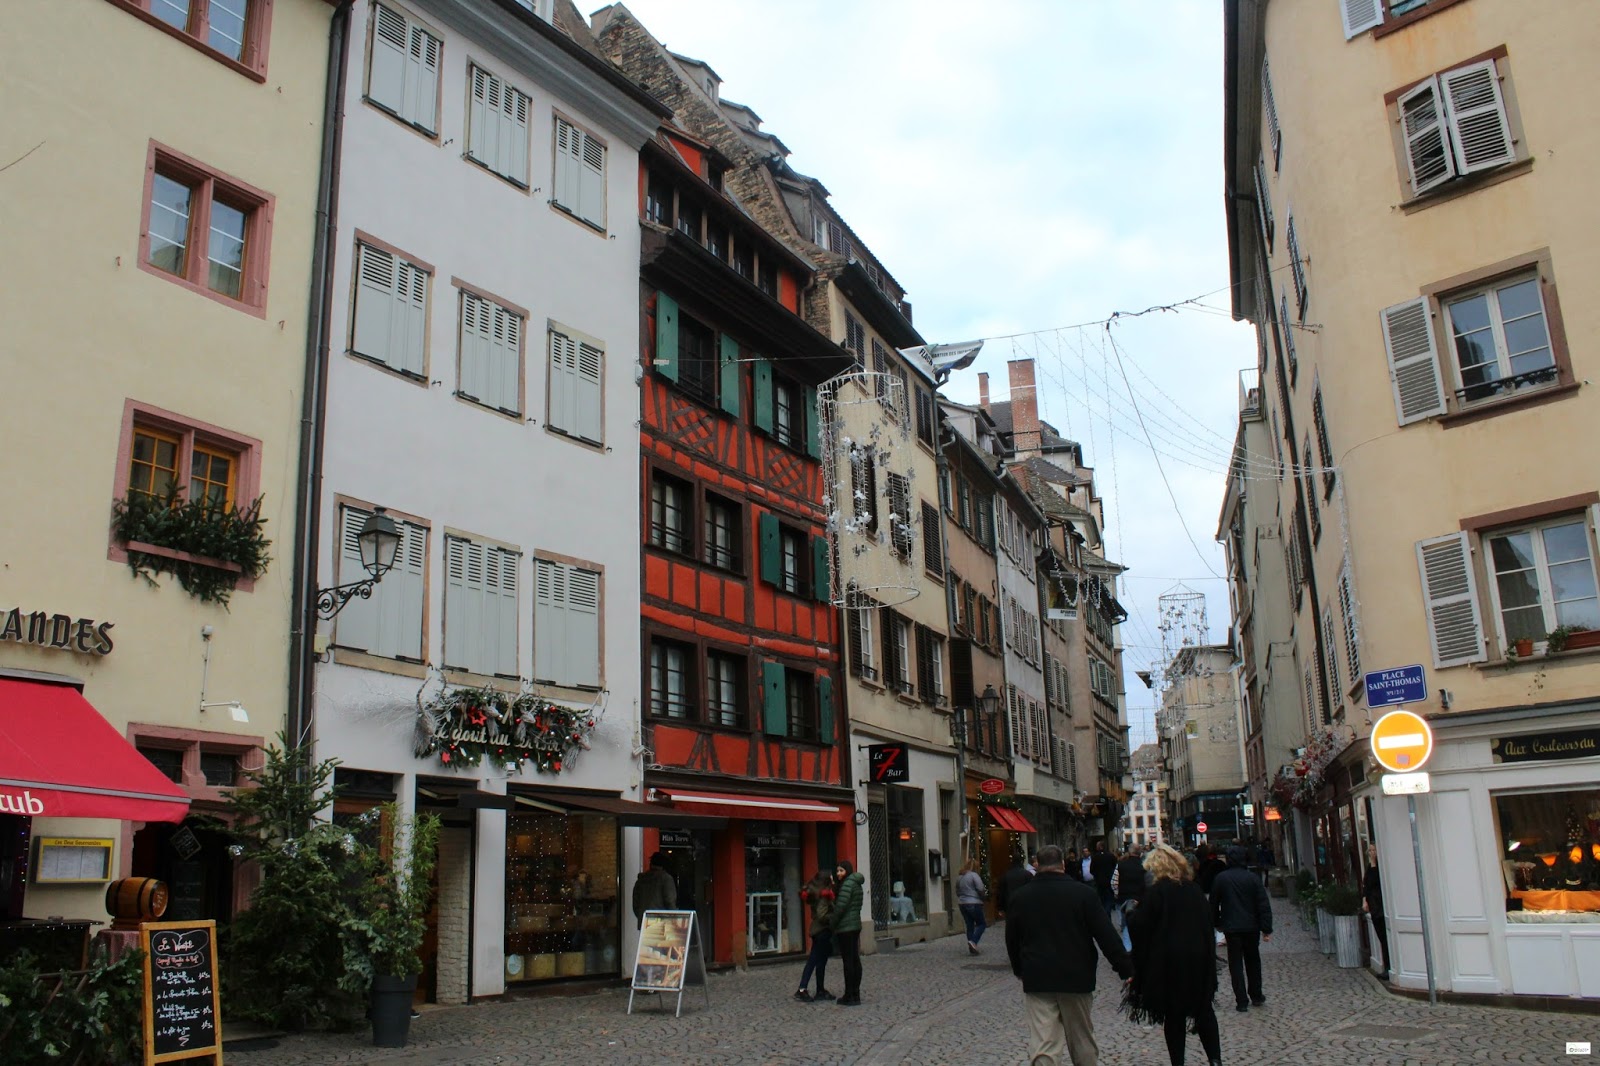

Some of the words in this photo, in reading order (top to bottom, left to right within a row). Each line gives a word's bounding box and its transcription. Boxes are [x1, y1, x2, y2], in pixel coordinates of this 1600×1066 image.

[0, 607, 116, 655] ANDES
[1368, 676, 1421, 691] SAINT-THOMAS
[1382, 671, 1405, 681] PLACE
[1505, 741, 1526, 756] Aux
[1532, 739, 1579, 754] Couleurs
[1579, 737, 1596, 749] du
[874, 752, 883, 760] Le
[876, 747, 902, 782] 7
[887, 769, 904, 777] Bar
